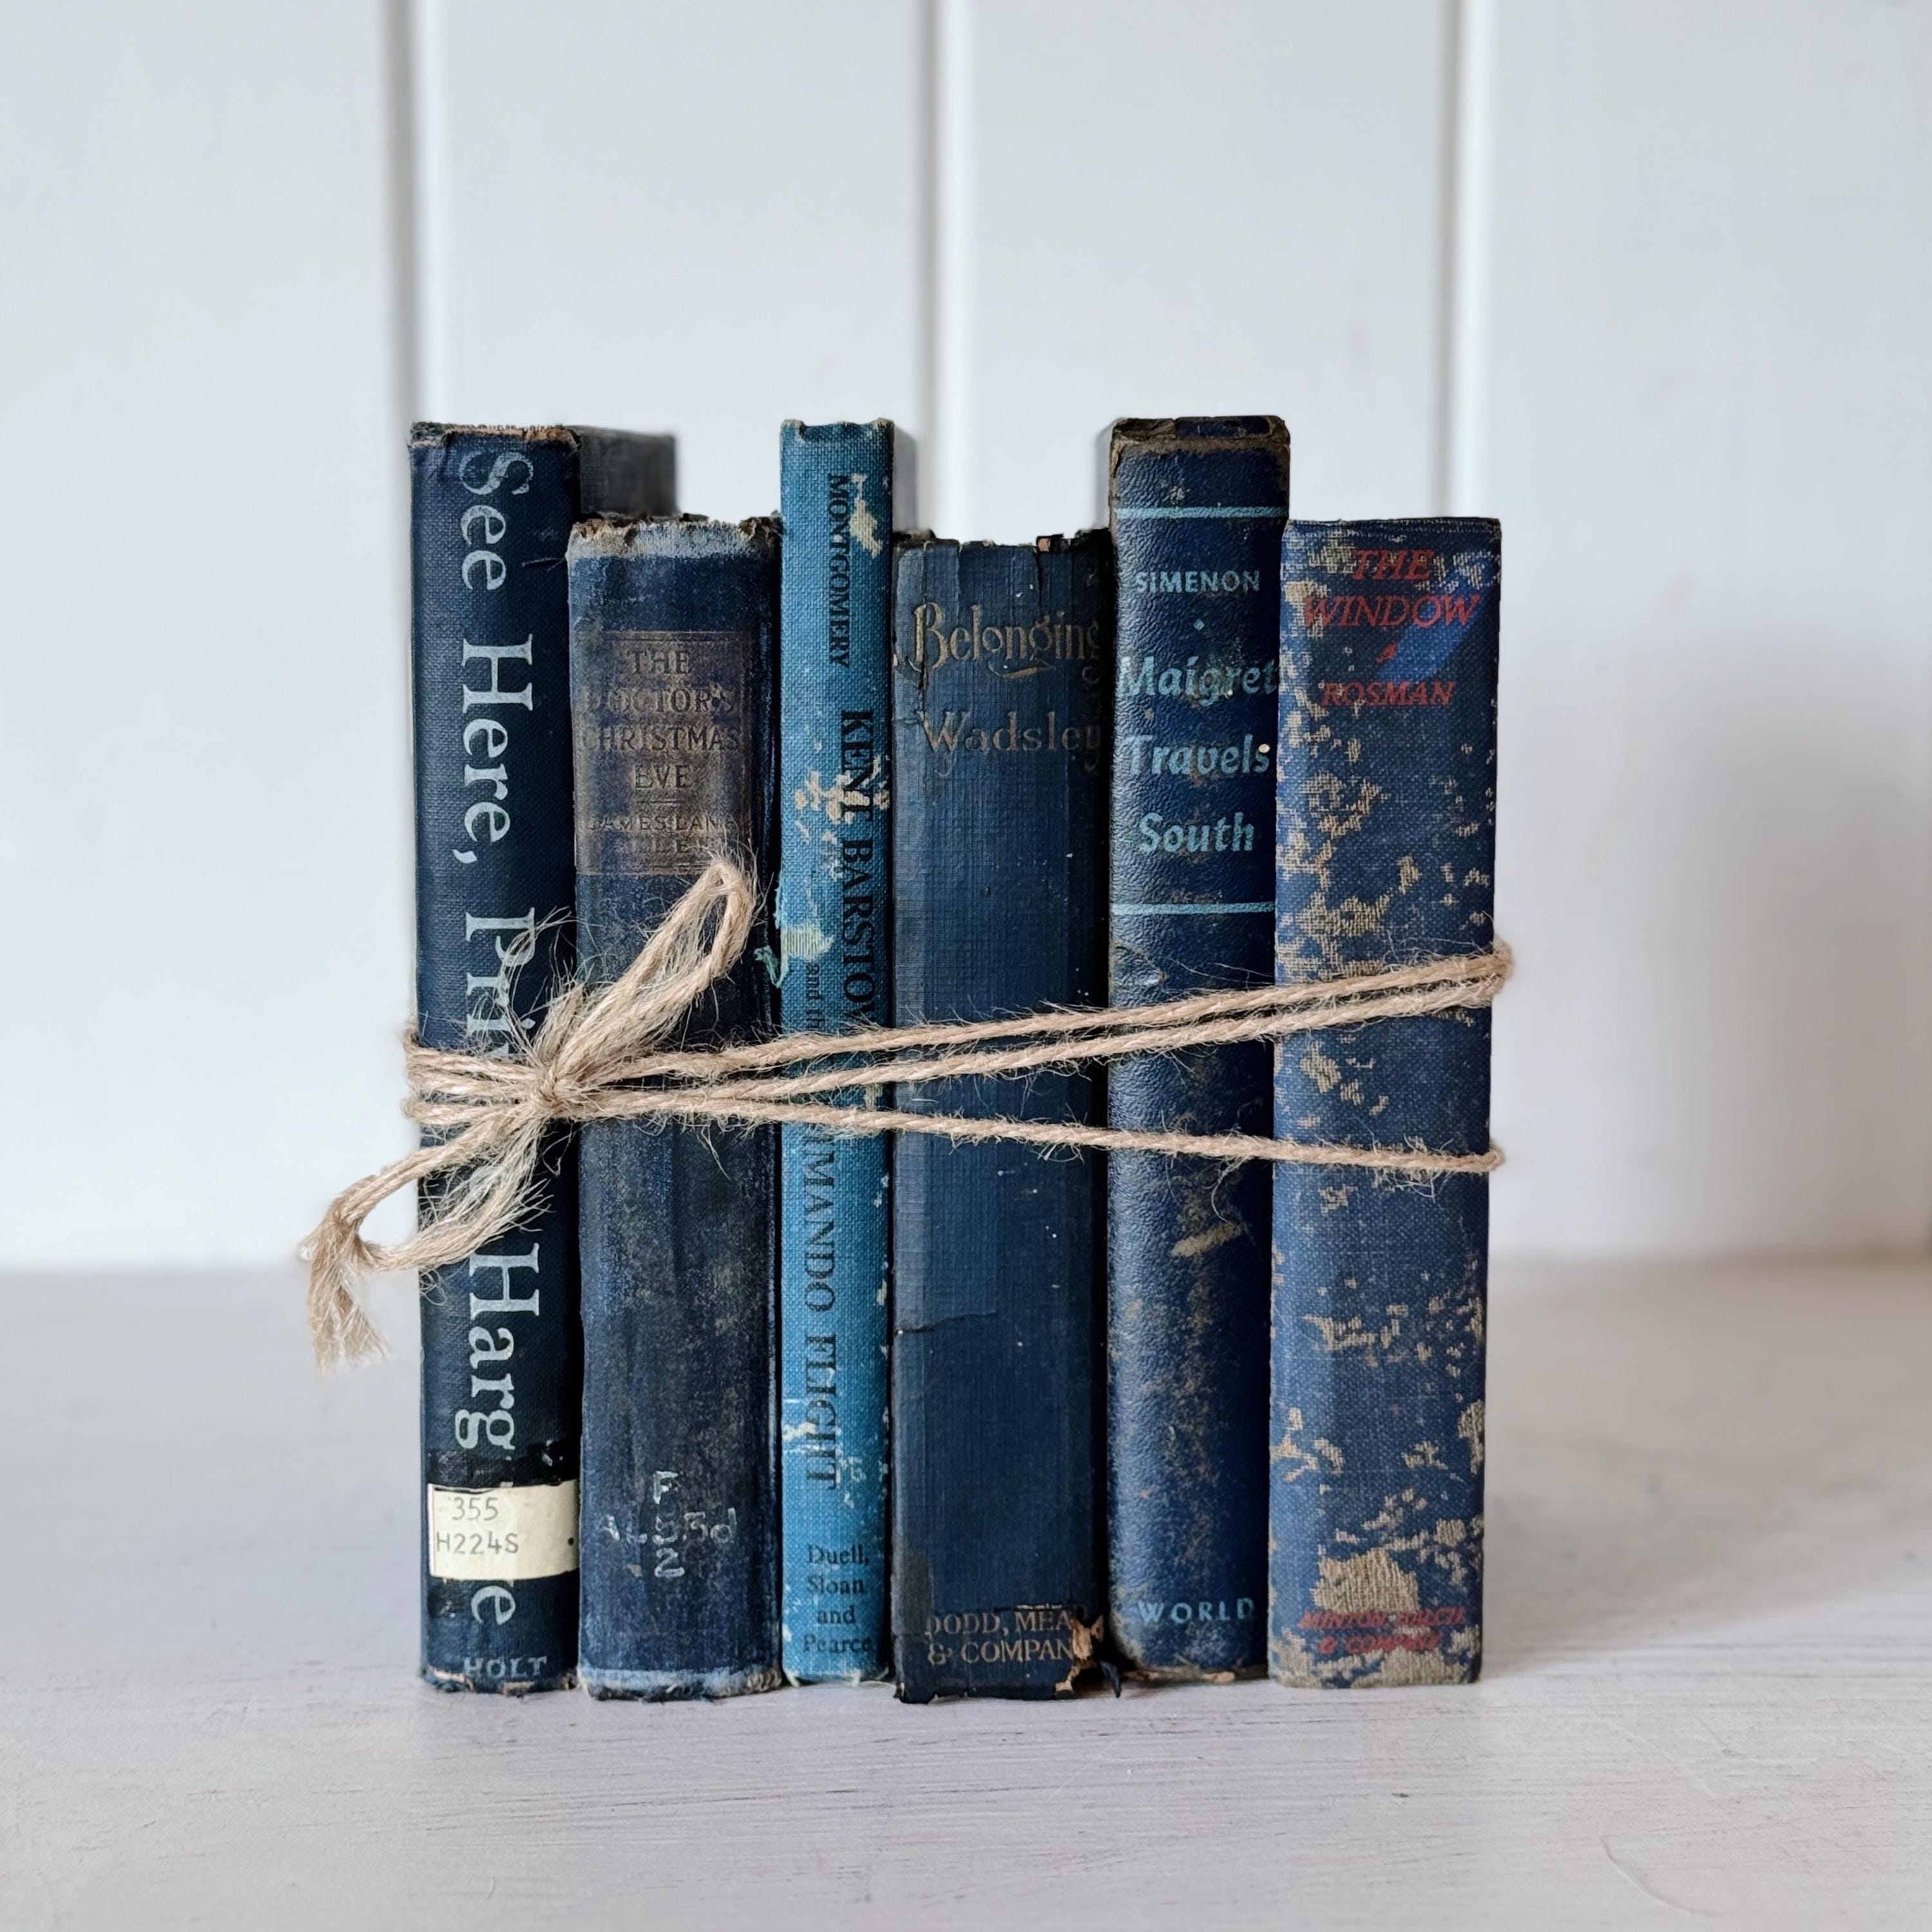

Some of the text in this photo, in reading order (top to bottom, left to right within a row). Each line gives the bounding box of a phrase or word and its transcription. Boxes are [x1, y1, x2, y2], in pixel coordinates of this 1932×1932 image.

[458, 451, 534, 591] See
[827, 473, 851, 668] MONTGOMERY
[1353, 549, 1435, 581] THE
[1133, 569, 1260, 594] SIMENON
[1303, 594, 1481, 629] WINDOW
[630, 650, 692, 674] THE
[1116, 656, 1278, 707] Maigret
[1320, 680, 1457, 707] ROSMAN
[452, 634, 533, 864] Here,
[916, 710, 1101, 777] Wadsley
[1128, 734, 1270, 775] Travels
[634, 764, 694, 790] EVE
[840, 709, 875, 822] KENT
[1138, 811, 1255, 855] South
[805, 963, 826, 1030] and th
[805, 1333, 837, 1490] FLIGHT
[456, 1242, 540, 1625] Harge
[452, 1497, 498, 1521] 355
[436, 1530, 519, 1555] H224S
[807, 1544, 870, 1566] Duell,
[806, 1573, 866, 1595] Sloan
[817, 1604, 856, 1624] and
[1137, 1596, 1255, 1625] WORLD
[803, 1633, 871, 1654] Pearce
[927, 1639, 1075, 1665] & COMPAN
[463, 1655, 547, 1677] HOLT
